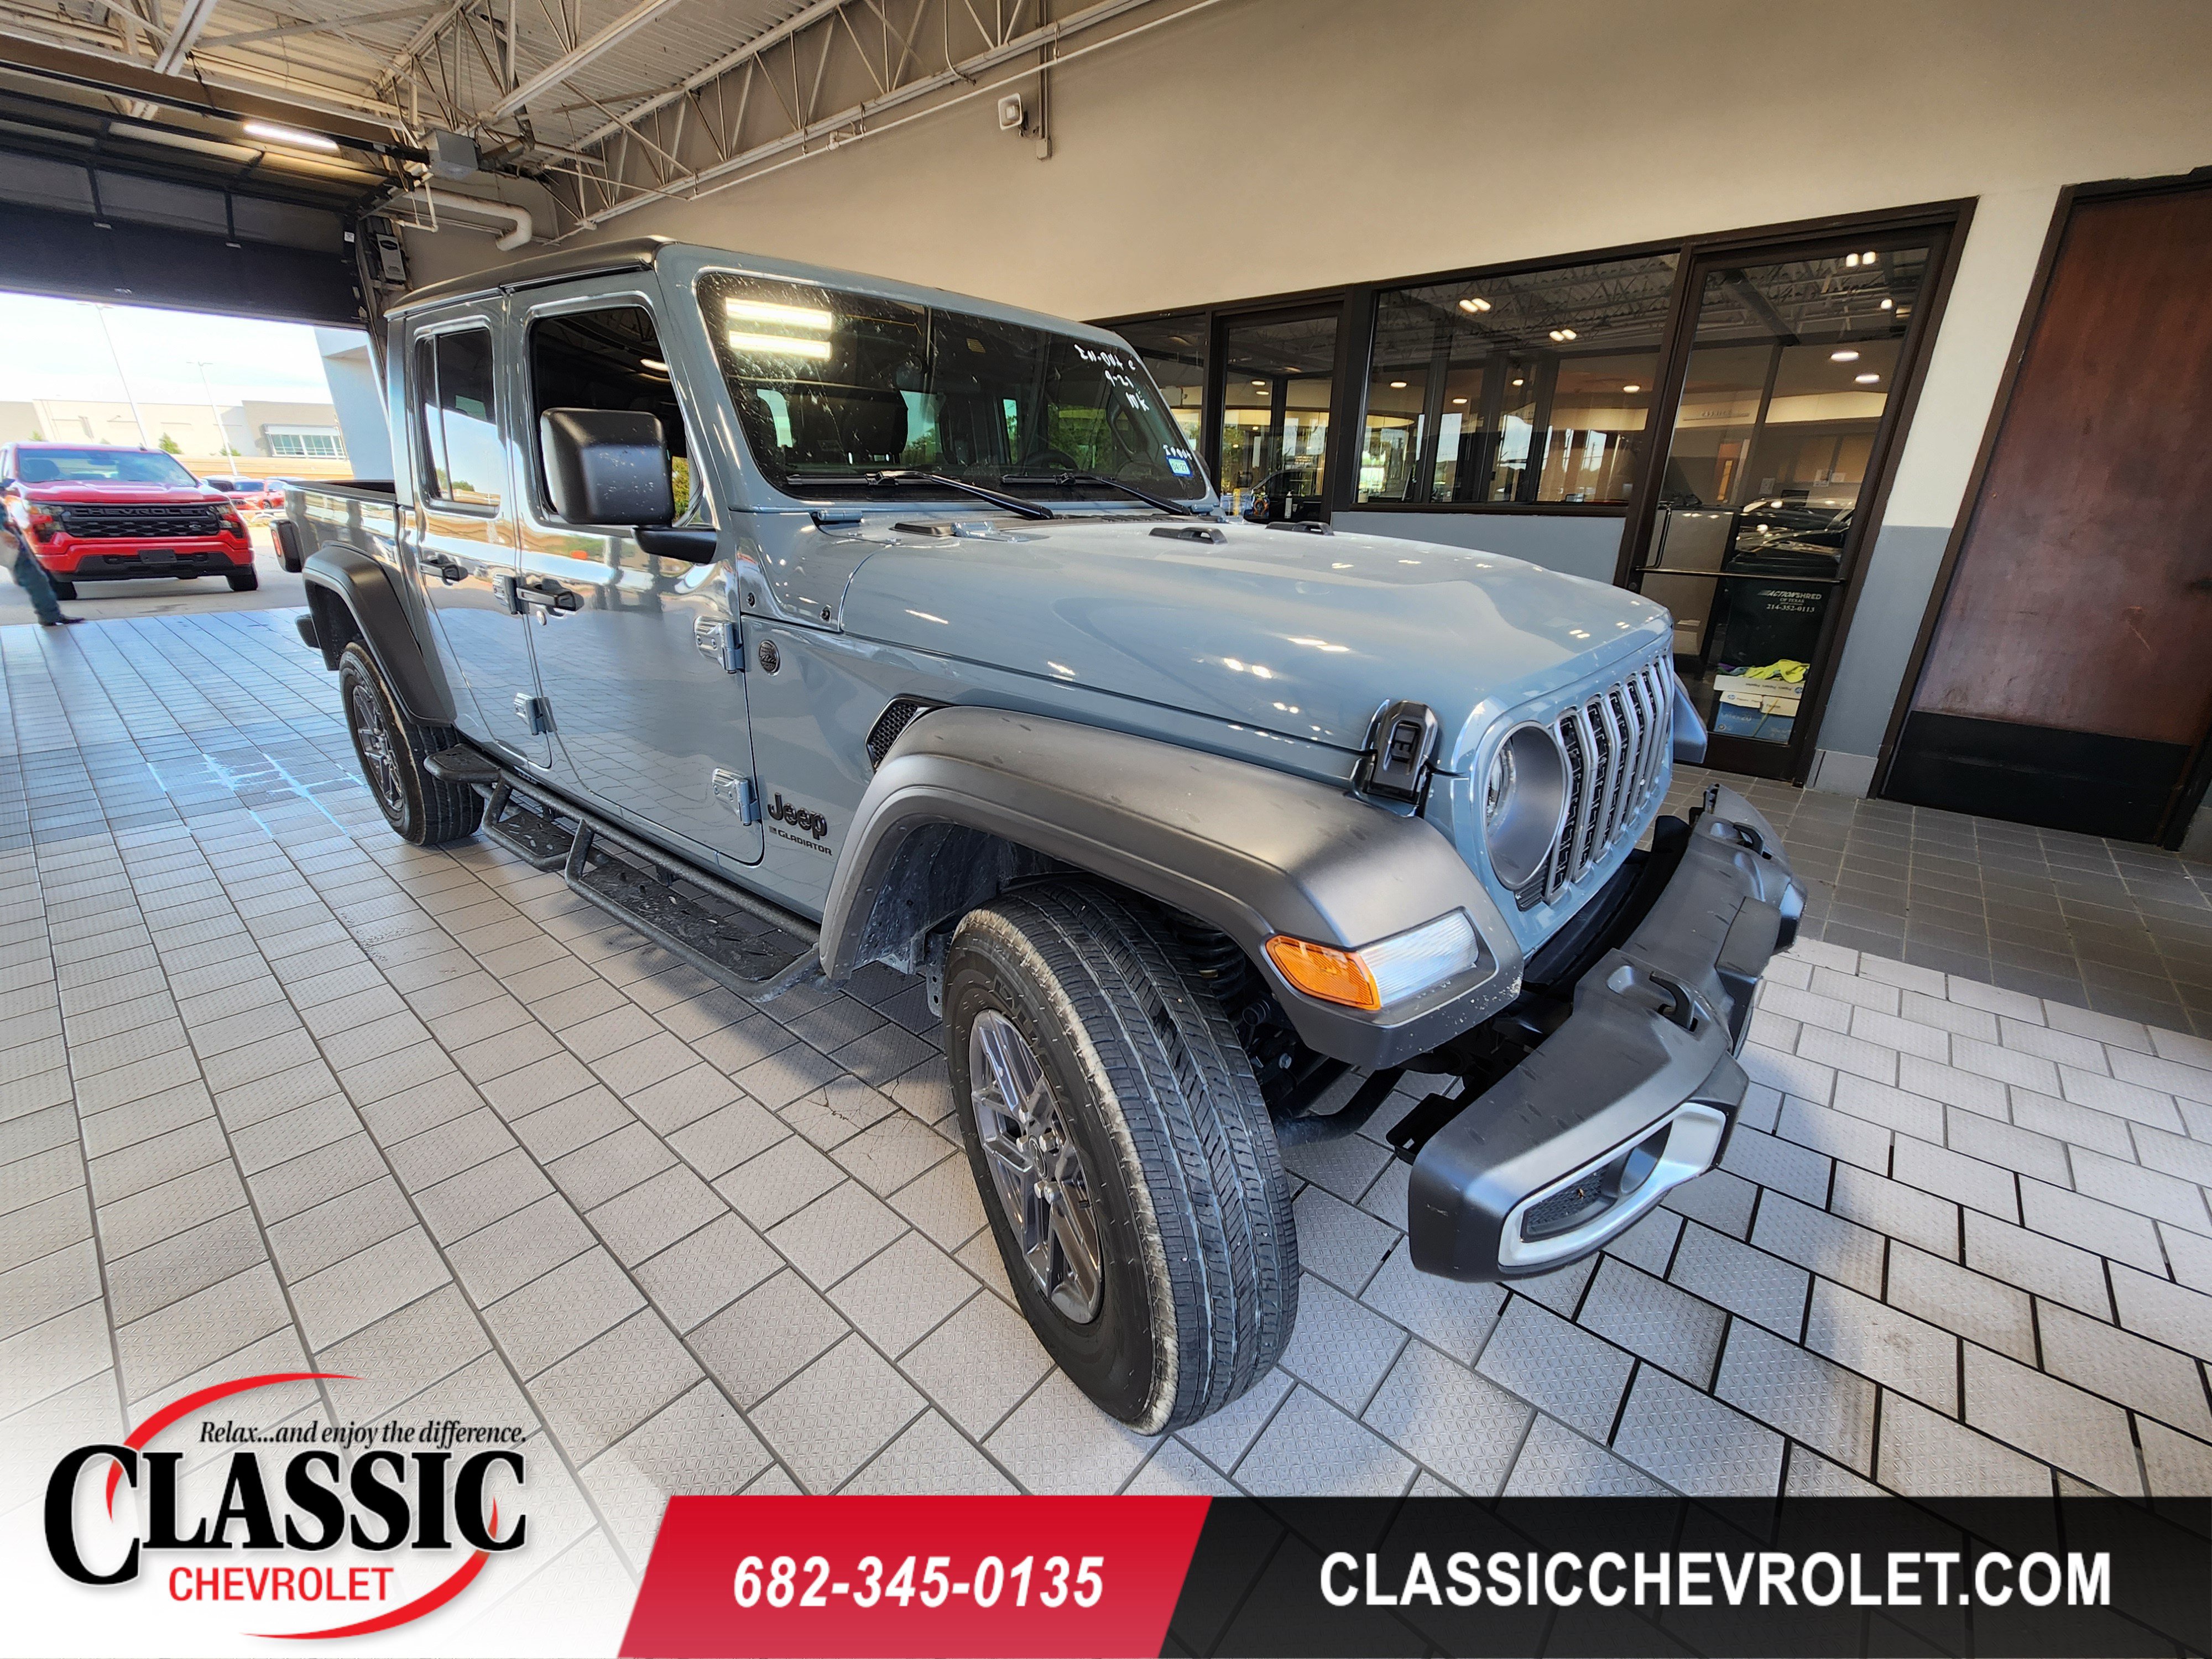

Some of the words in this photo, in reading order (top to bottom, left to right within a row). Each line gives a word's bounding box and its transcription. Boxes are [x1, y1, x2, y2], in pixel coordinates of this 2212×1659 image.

[74, 507, 205, 516] CHEVROLET
[767, 792, 828, 841] Jeep
[778, 830, 833, 856] GLADIATOR
